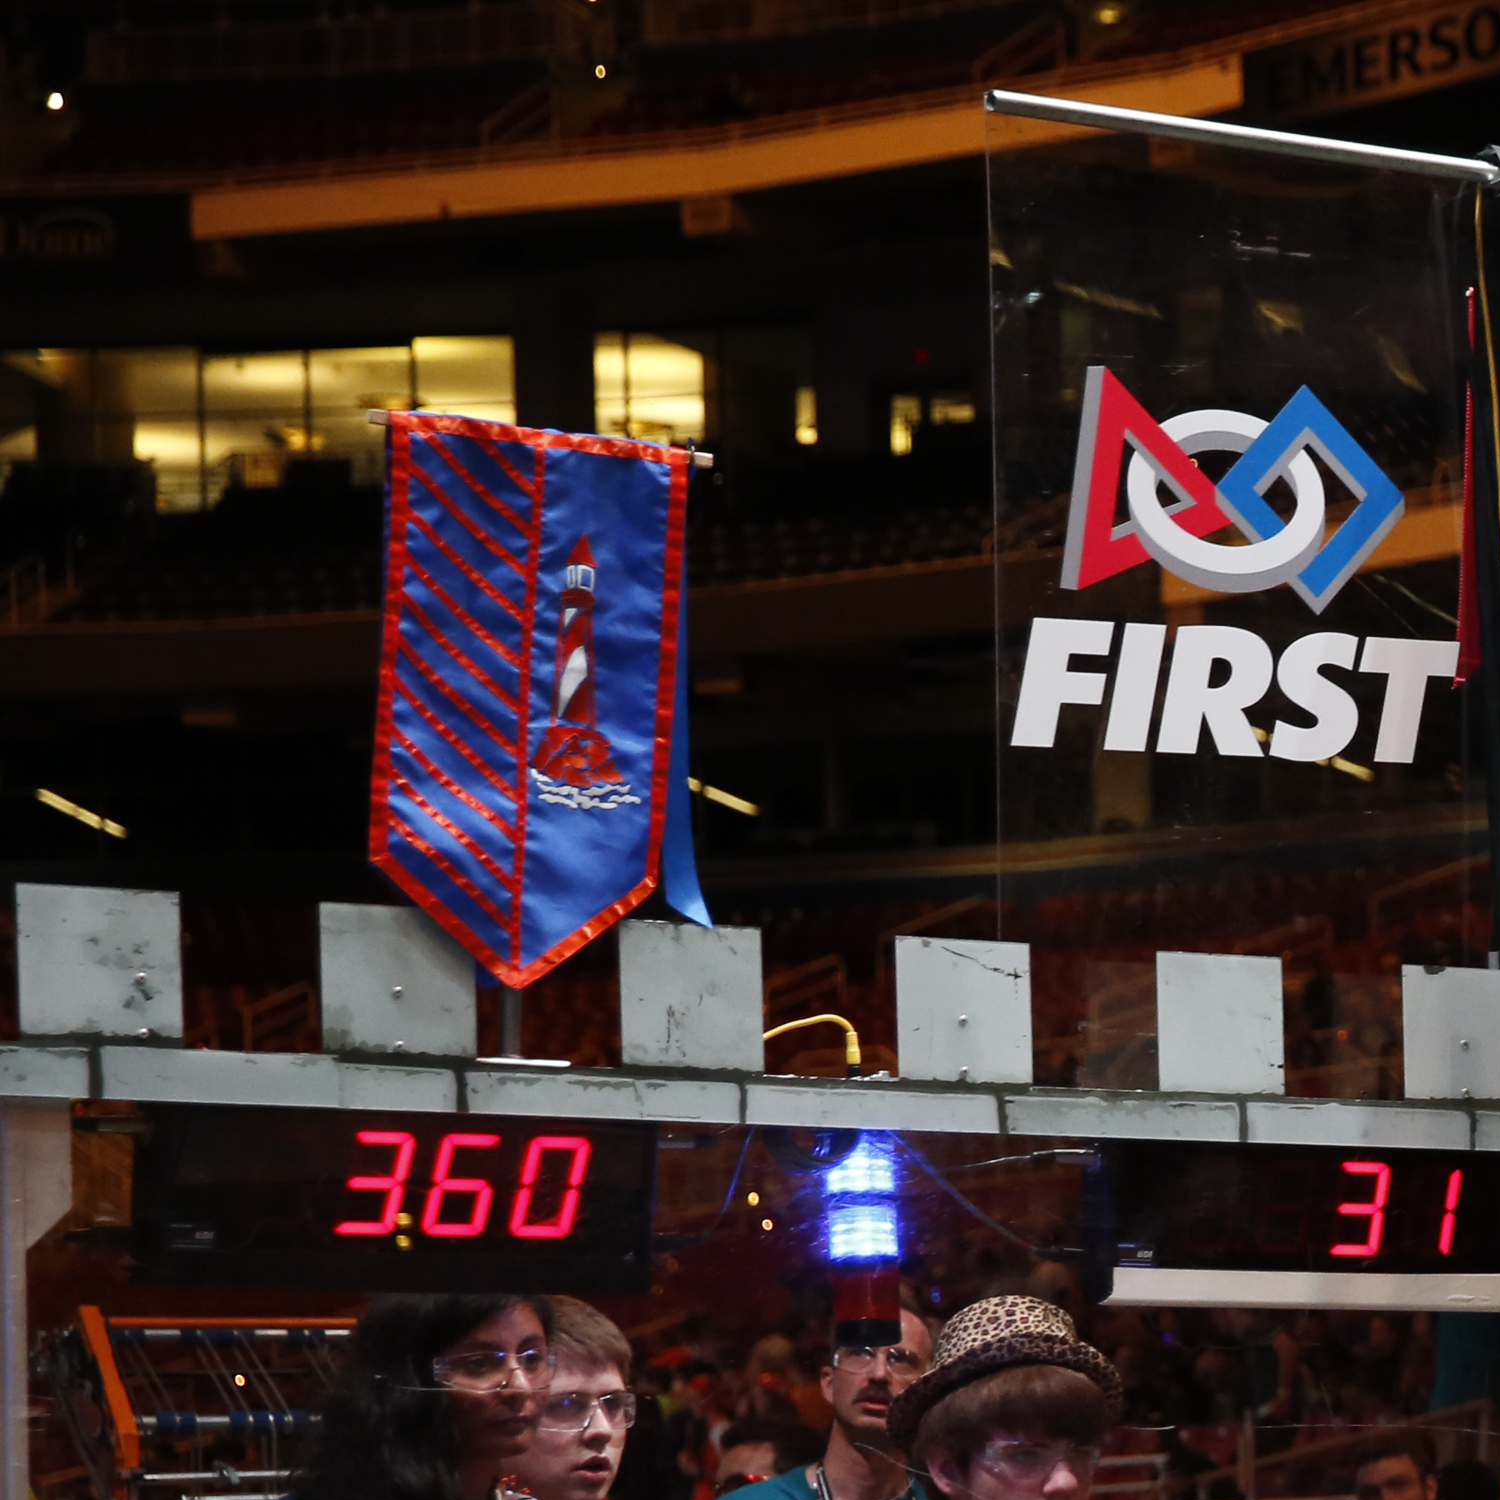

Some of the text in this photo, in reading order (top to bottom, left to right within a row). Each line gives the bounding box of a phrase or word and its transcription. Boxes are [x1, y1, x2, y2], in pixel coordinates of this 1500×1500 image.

[1010, 617, 1461, 764] FIRST
[334, 1130, 592, 1238] 360
[1330, 1161, 1462, 1257] 31
